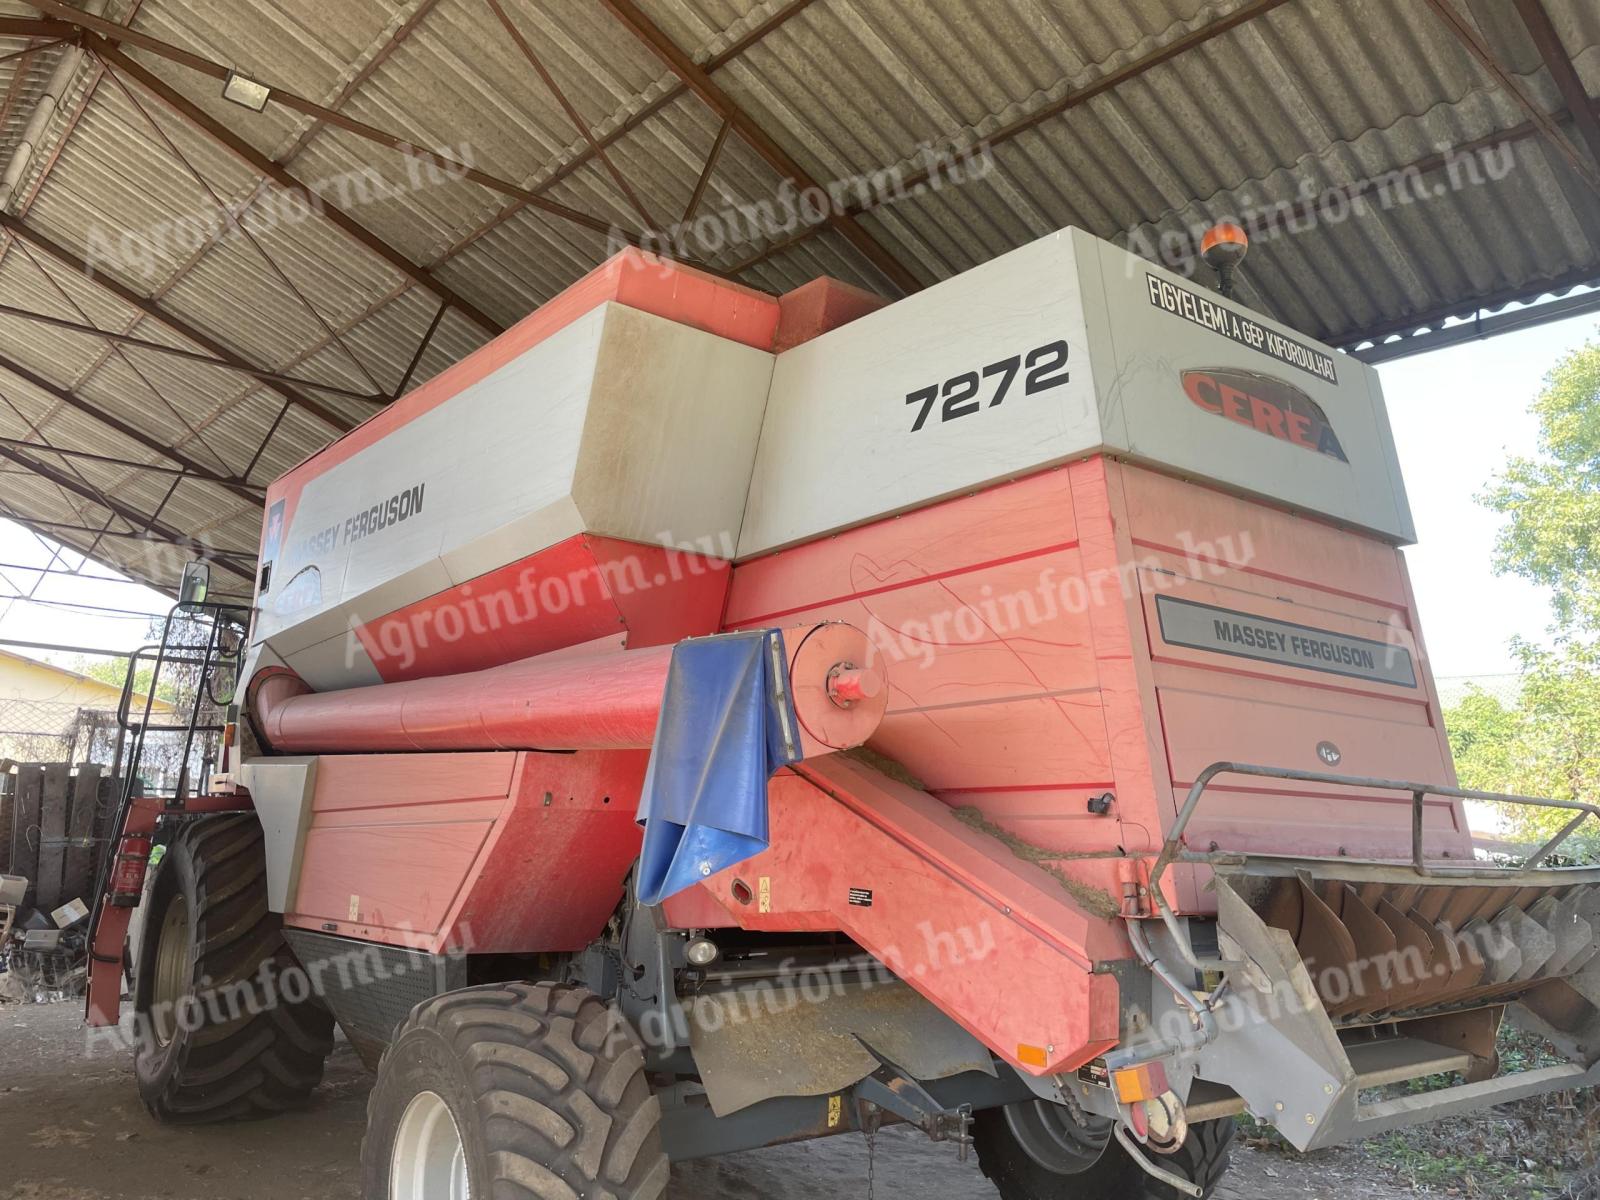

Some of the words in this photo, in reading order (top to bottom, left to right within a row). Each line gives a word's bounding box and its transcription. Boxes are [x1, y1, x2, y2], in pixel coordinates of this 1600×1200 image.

[1147, 275, 1230, 336] FIGYELEM!
[1232, 316, 1242, 340] A
[1241, 322, 1265, 348] GÉP
[1266, 331, 1335, 380] KIFORDULHAT
[905, 340, 1070, 432] 7272
[343, 483, 425, 546] FERGUSON
[1214, 619, 1288, 652] MASSEY
[1291, 636, 1375, 669] FERGUSON
